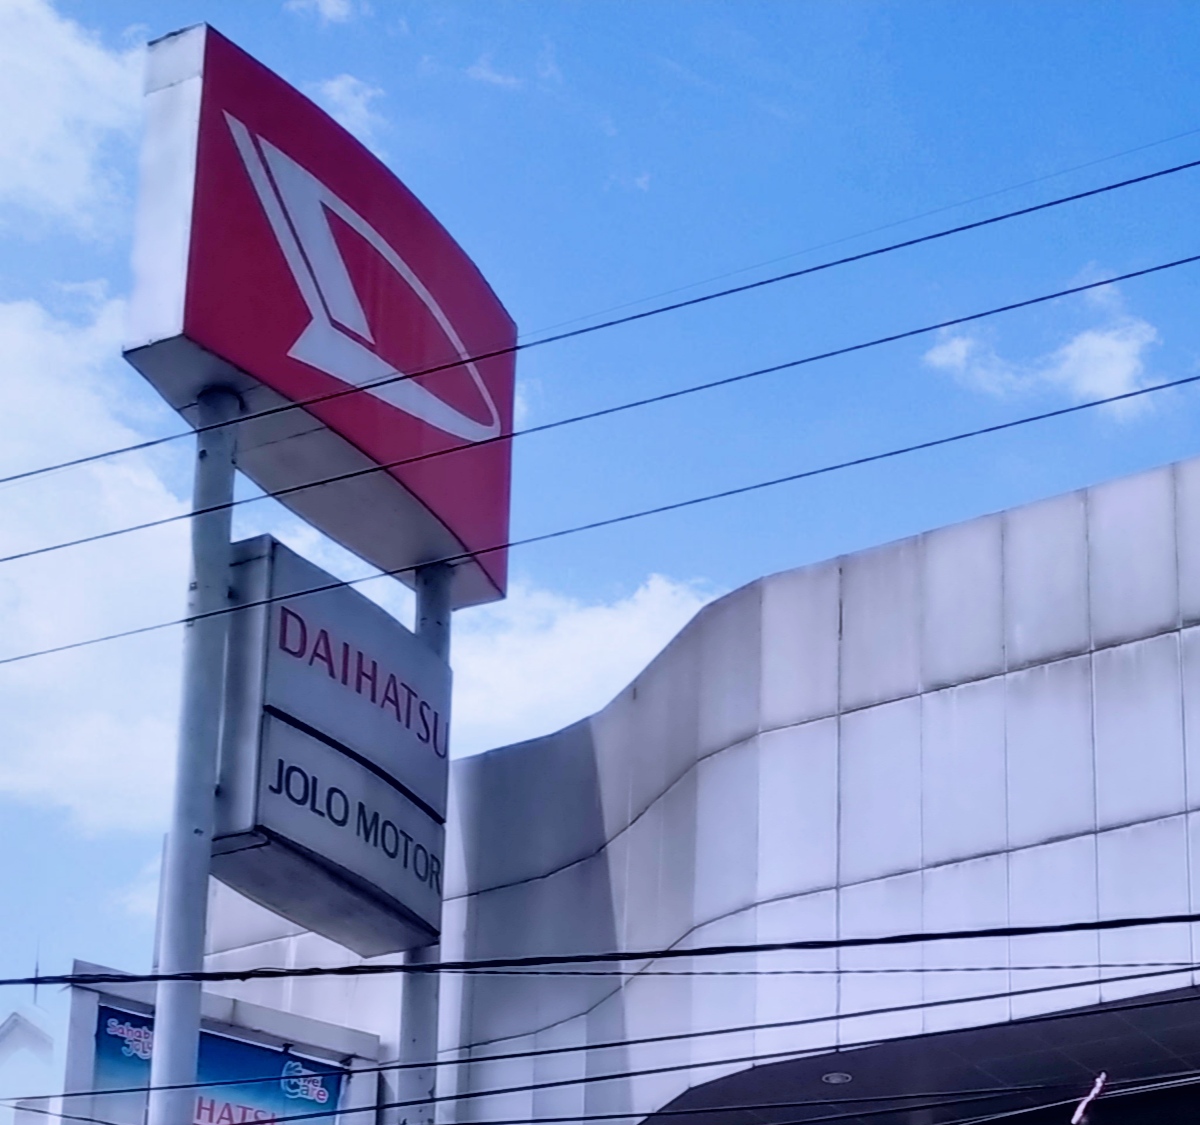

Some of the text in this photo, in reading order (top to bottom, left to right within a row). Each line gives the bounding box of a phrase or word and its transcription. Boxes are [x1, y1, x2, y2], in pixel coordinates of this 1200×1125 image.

[279, 606, 449, 759] DAIHATSU
[269, 759, 442, 896] JOLO MOTOR
